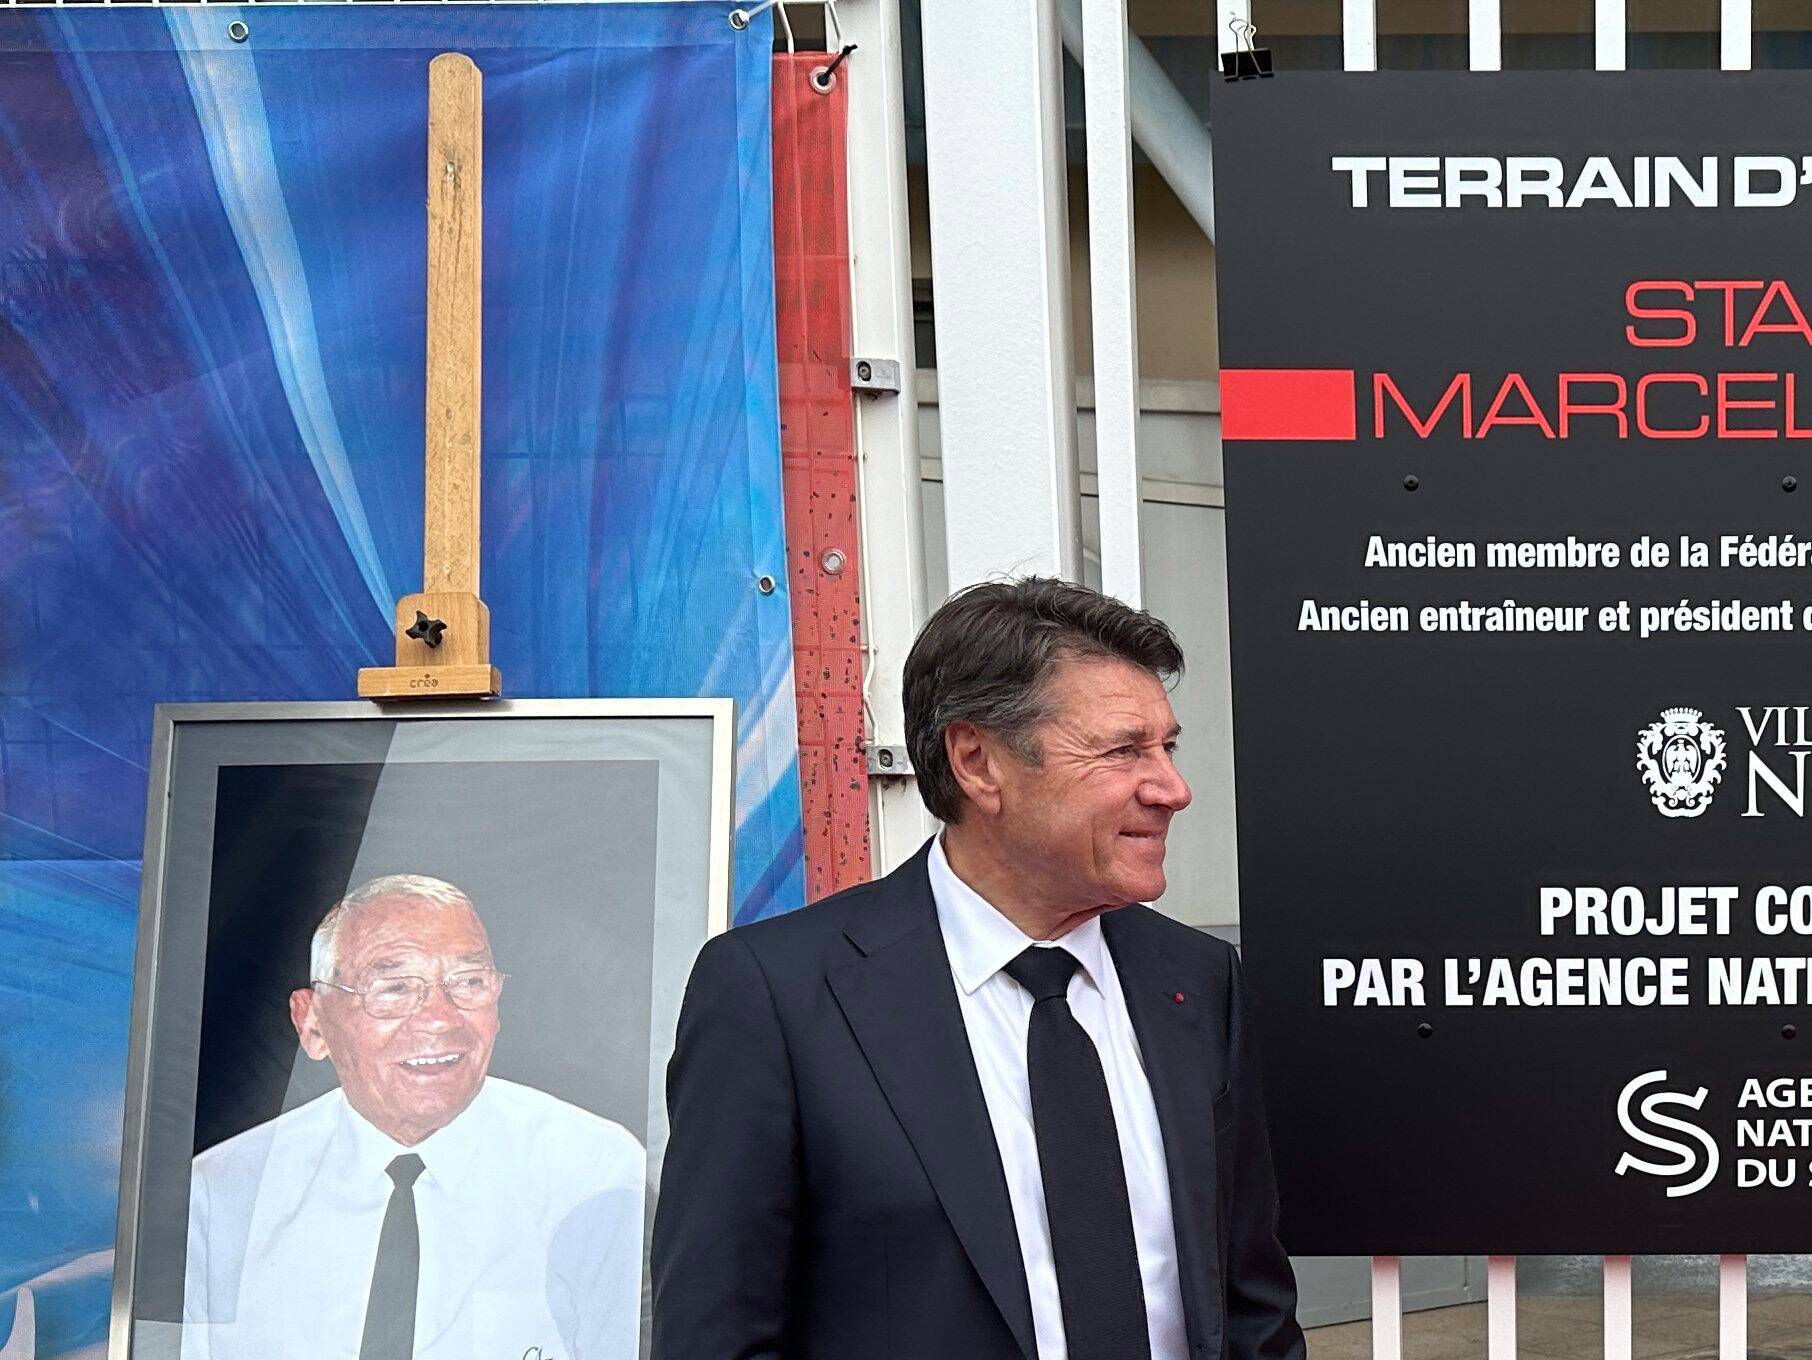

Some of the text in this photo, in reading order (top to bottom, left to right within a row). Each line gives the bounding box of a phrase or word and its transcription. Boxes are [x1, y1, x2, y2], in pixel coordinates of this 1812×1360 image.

[1332, 157, 1718, 207] TERRAIN
[1365, 536, 1475, 567] Ancien
[1487, 536, 1620, 567] membre
[1630, 536, 1669, 567] de
[1681, 536, 1708, 567] la
[1298, 600, 1409, 631] Ancien
[1420, 600, 1589, 631] entraîneur
[1599, 601, 1630, 631] et
[1641, 599, 1793, 638] président
[1541, 887, 1738, 935] PROJET
[1323, 959, 1426, 1006] PAR
[1445, 957, 1689, 1006] L’AGENCE
[1738, 1159, 1795, 1187] DU
